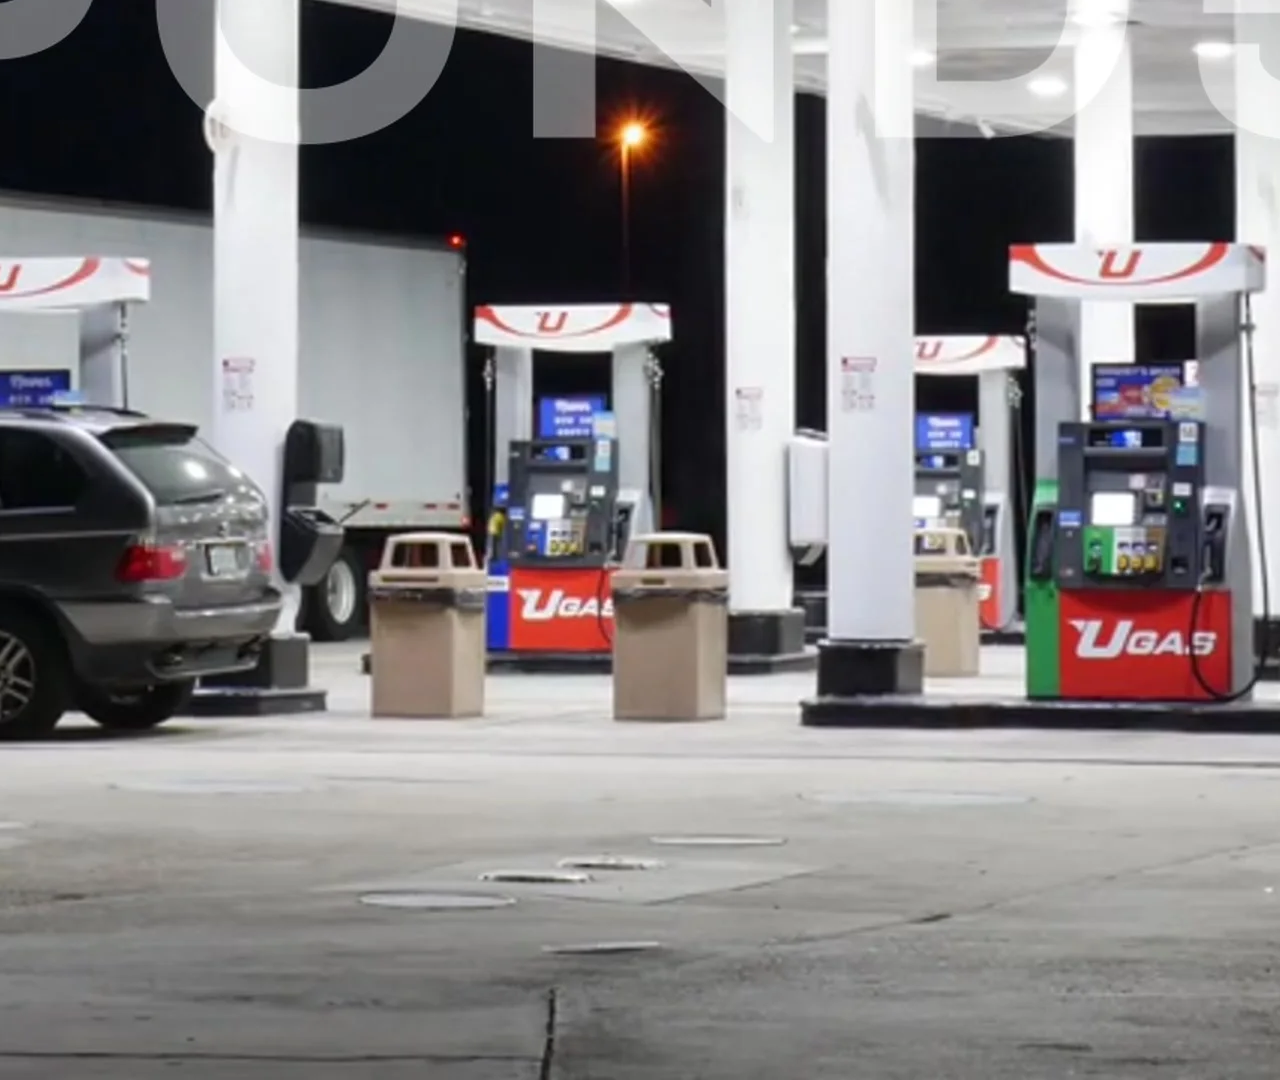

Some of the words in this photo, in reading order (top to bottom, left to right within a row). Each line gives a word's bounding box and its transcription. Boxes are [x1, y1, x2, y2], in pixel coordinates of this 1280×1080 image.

[1097, 251, 1142, 279] U
[535, 311, 568, 333] U
[1068, 619, 1218, 659] UGAS
